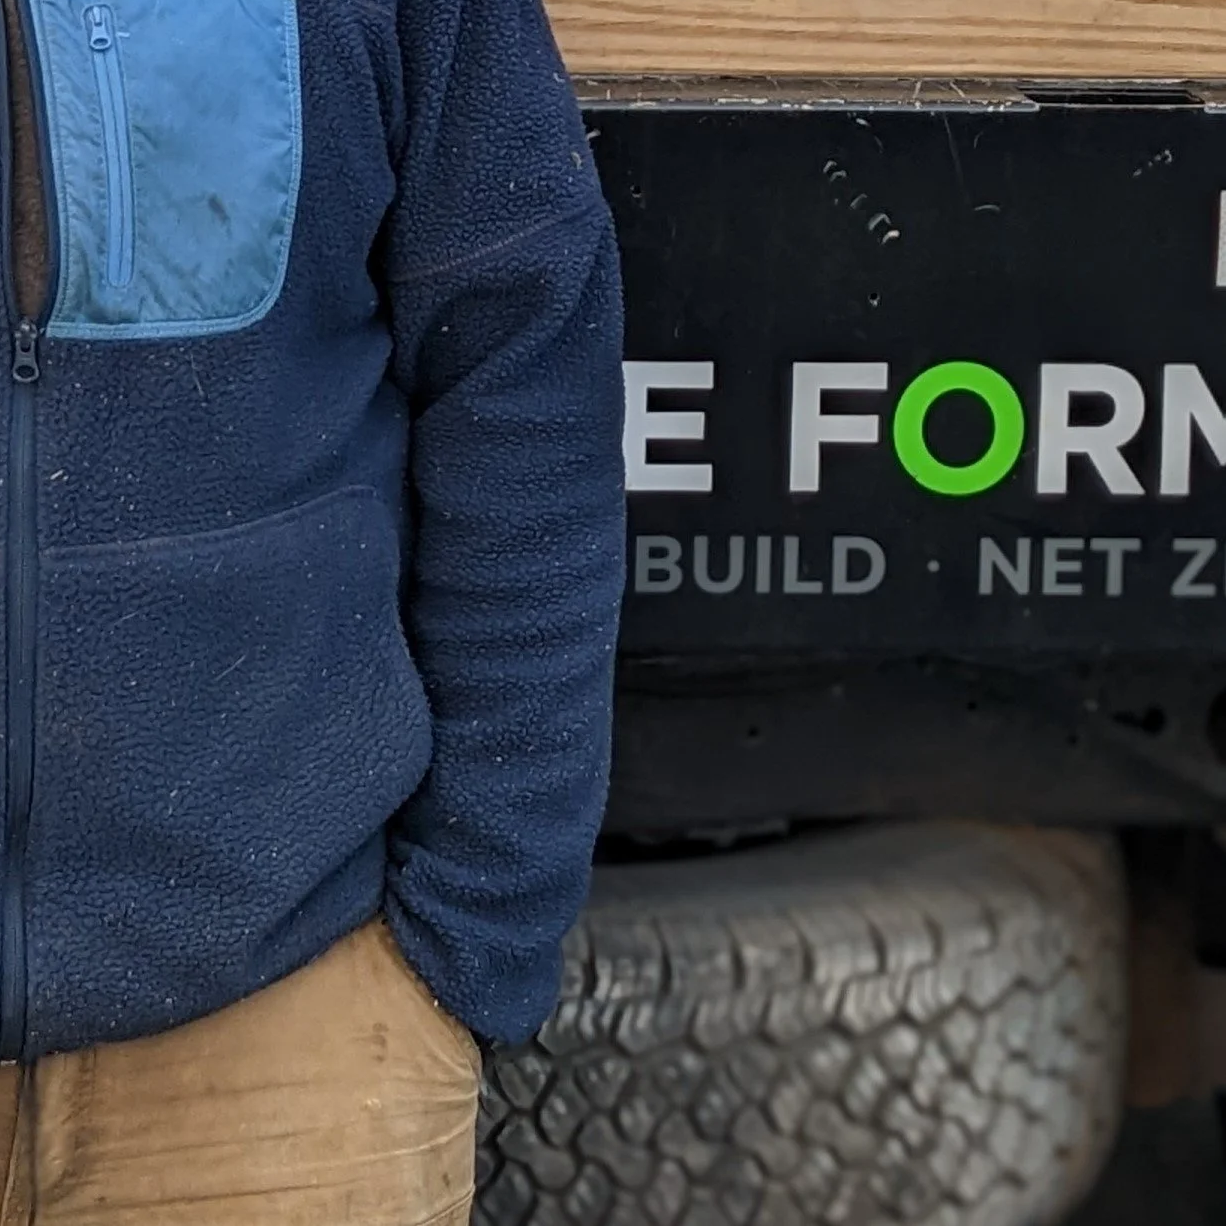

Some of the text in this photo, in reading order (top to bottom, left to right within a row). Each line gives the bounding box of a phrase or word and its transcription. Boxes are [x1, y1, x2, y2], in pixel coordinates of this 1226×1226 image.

[634, 535, 1226, 598] BUILD NET Z
